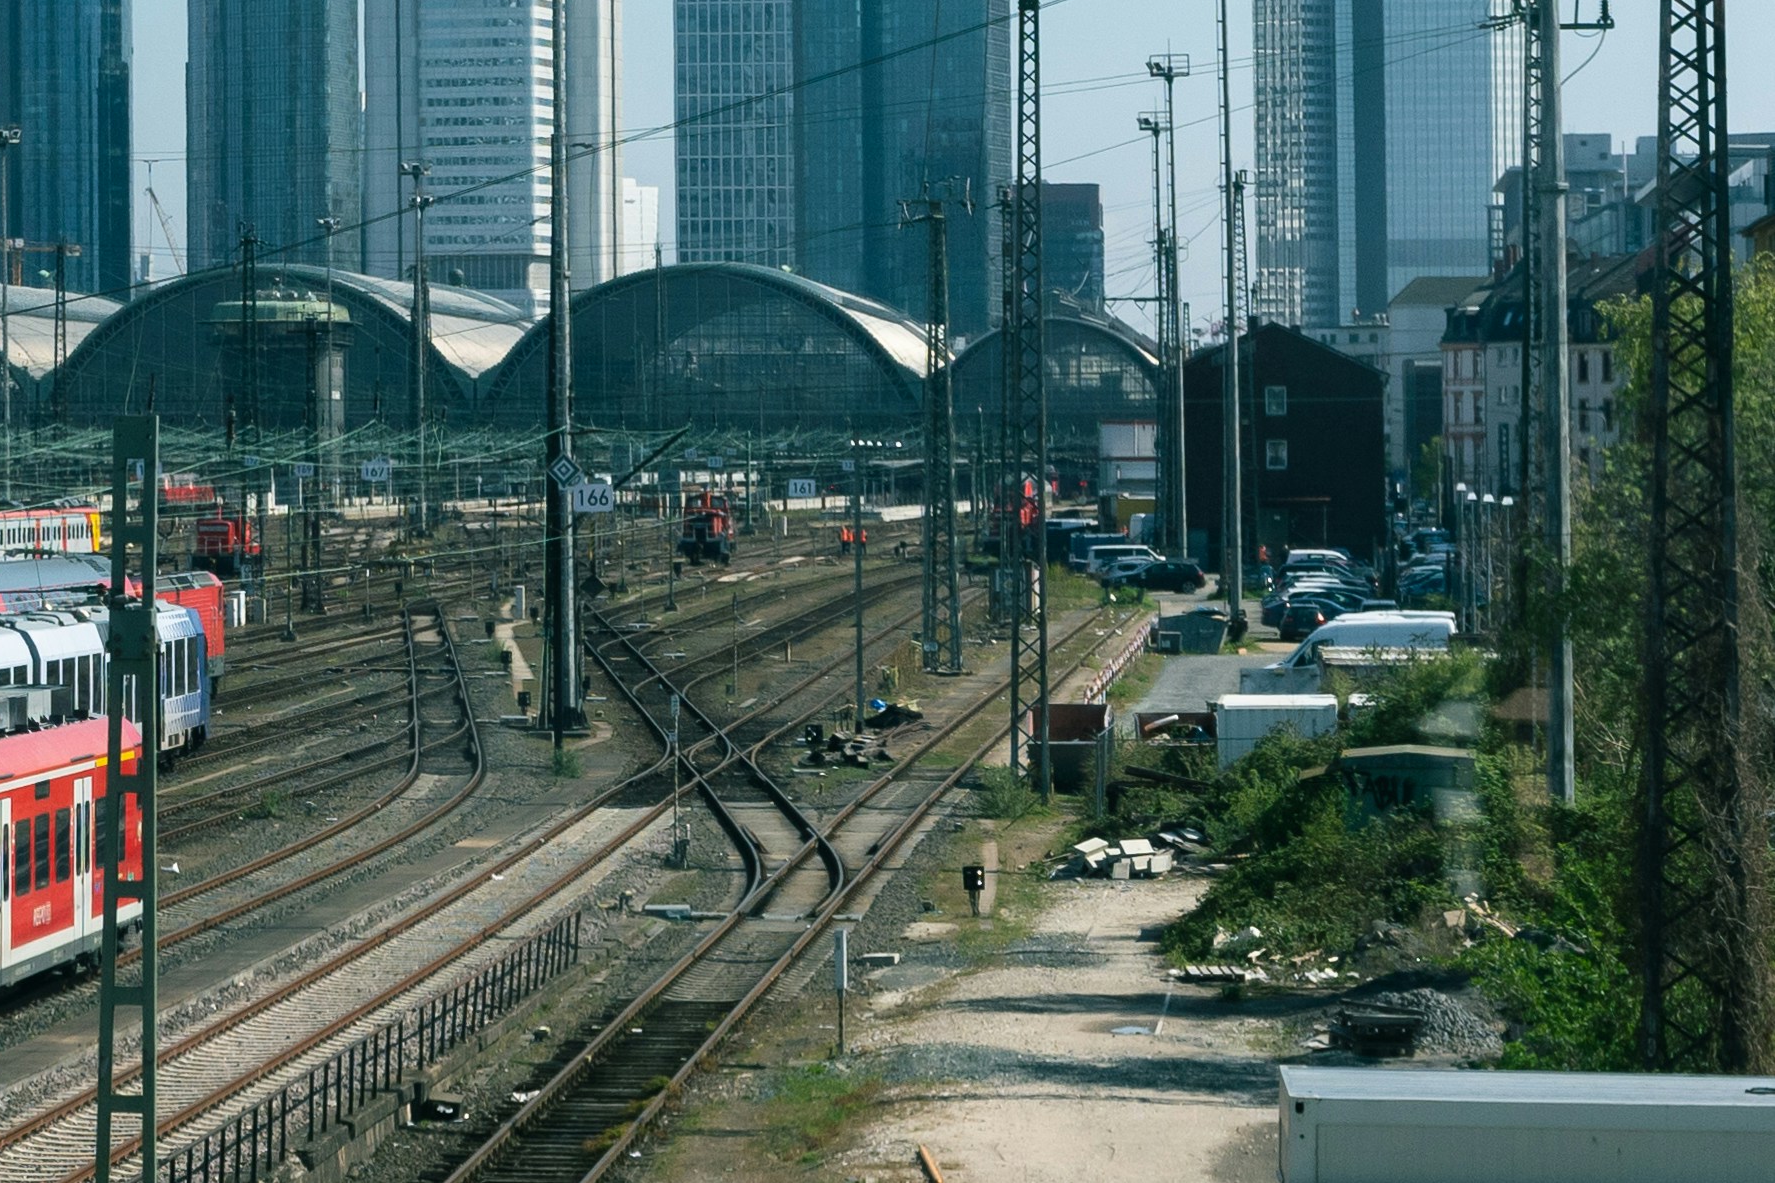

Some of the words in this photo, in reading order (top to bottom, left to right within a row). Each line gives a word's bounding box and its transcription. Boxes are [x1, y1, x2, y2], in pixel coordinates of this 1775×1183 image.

[366, 467, 385, 477] 167
[793, 481, 812, 494] 161
[578, 489, 609, 506] 166
